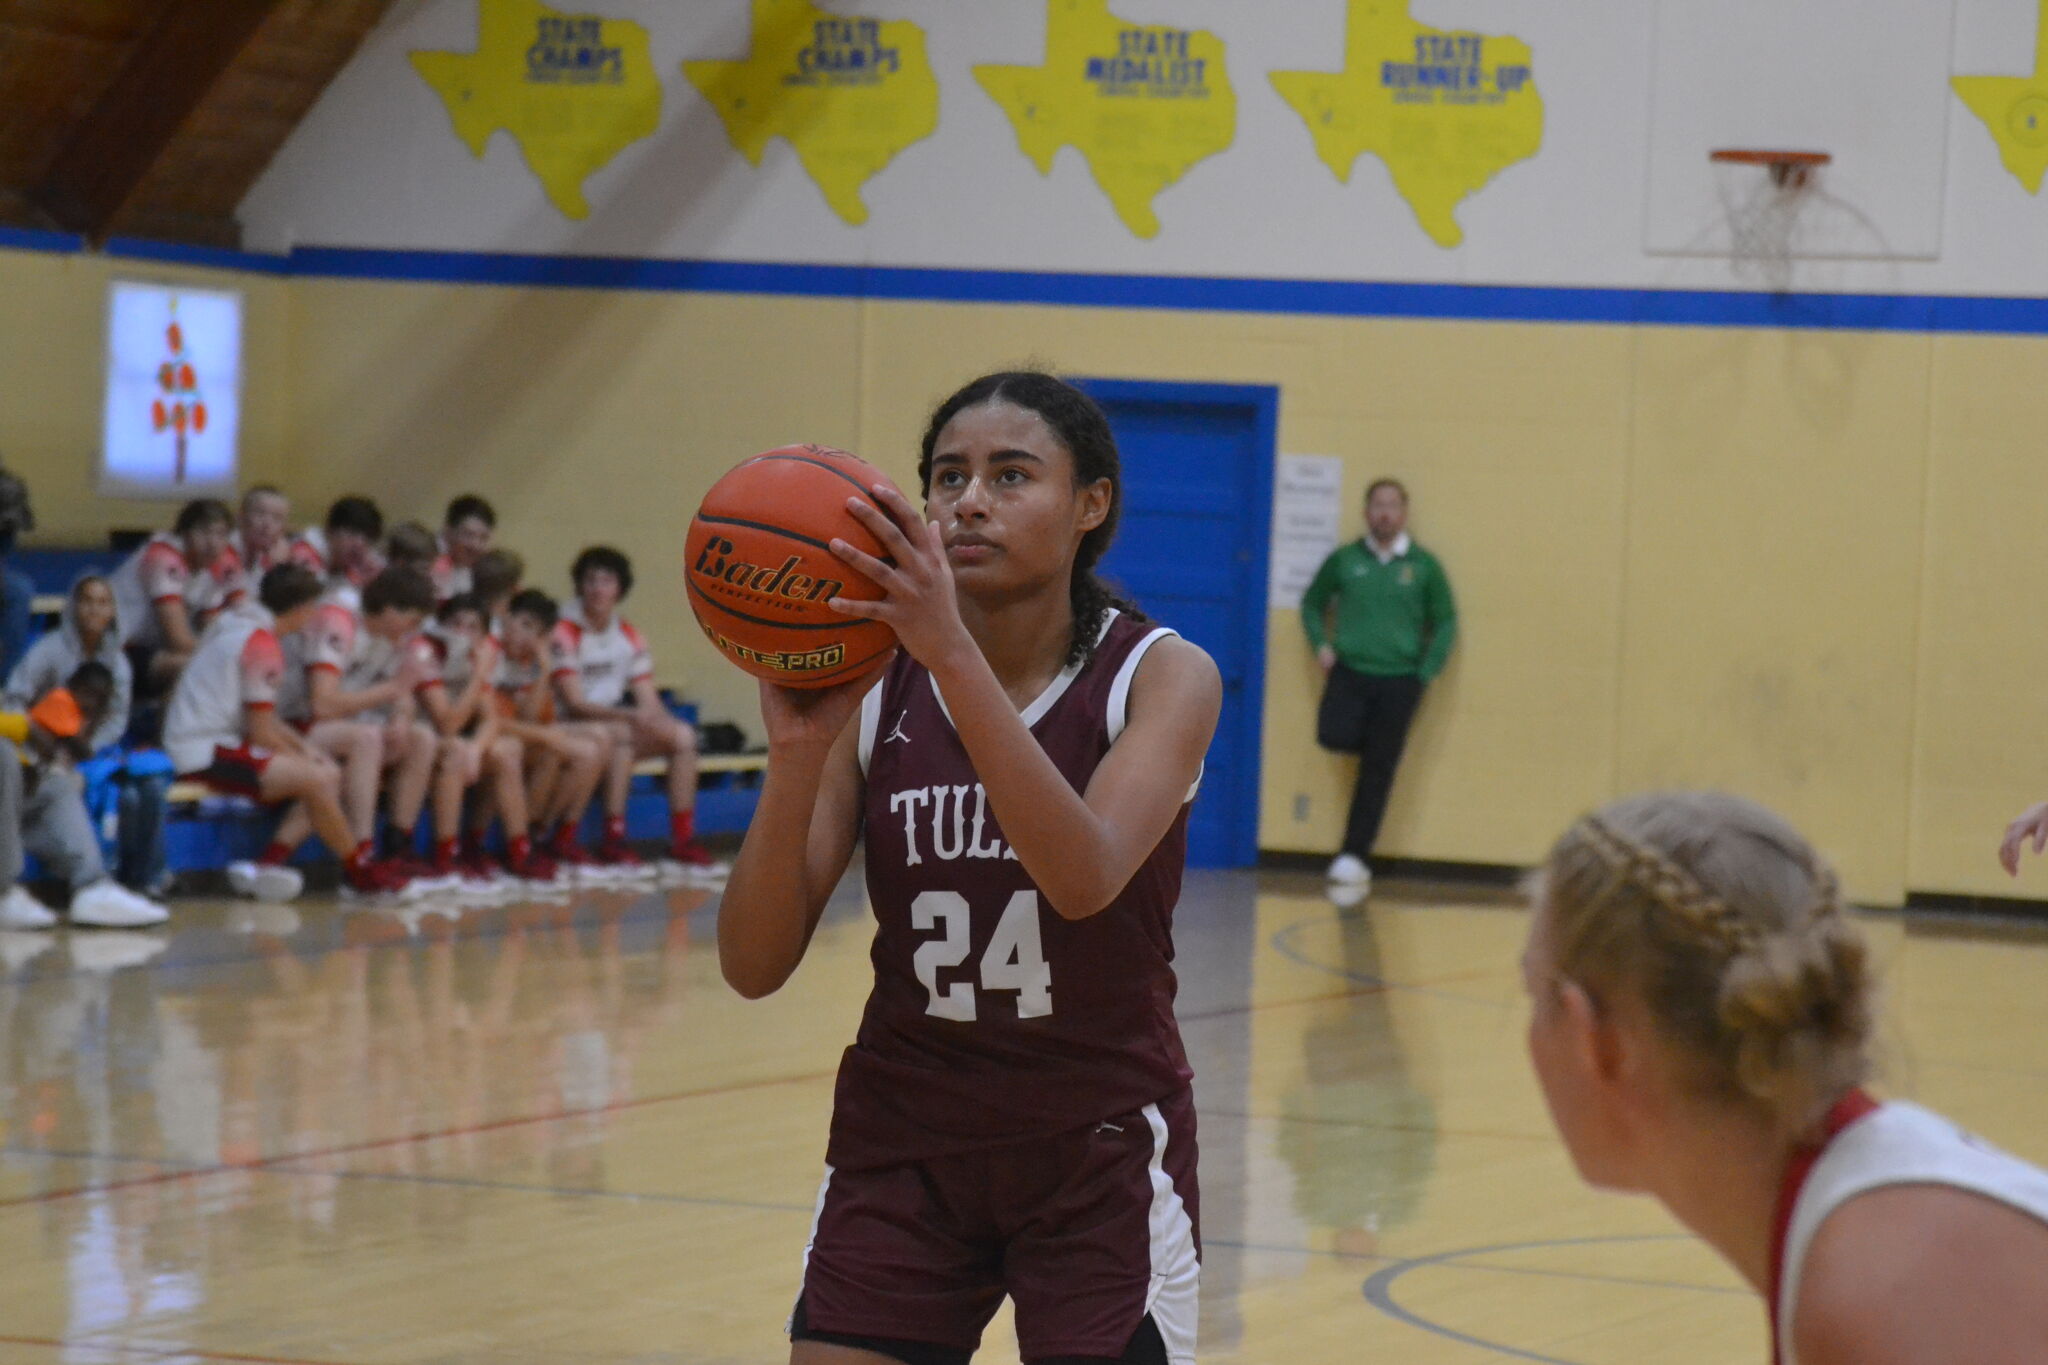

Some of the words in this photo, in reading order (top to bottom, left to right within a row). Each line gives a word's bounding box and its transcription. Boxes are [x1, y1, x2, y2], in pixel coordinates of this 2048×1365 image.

[1119, 30, 1188, 58] STATE
[1415, 36, 1481, 64] STATE
[1085, 57, 1205, 83] MEDALIST
[695, 535, 844, 604] Baden
[787, 647, 841, 671] PRO
[890, 782, 1019, 867] TUL
[910, 889, 1053, 1022] 24
